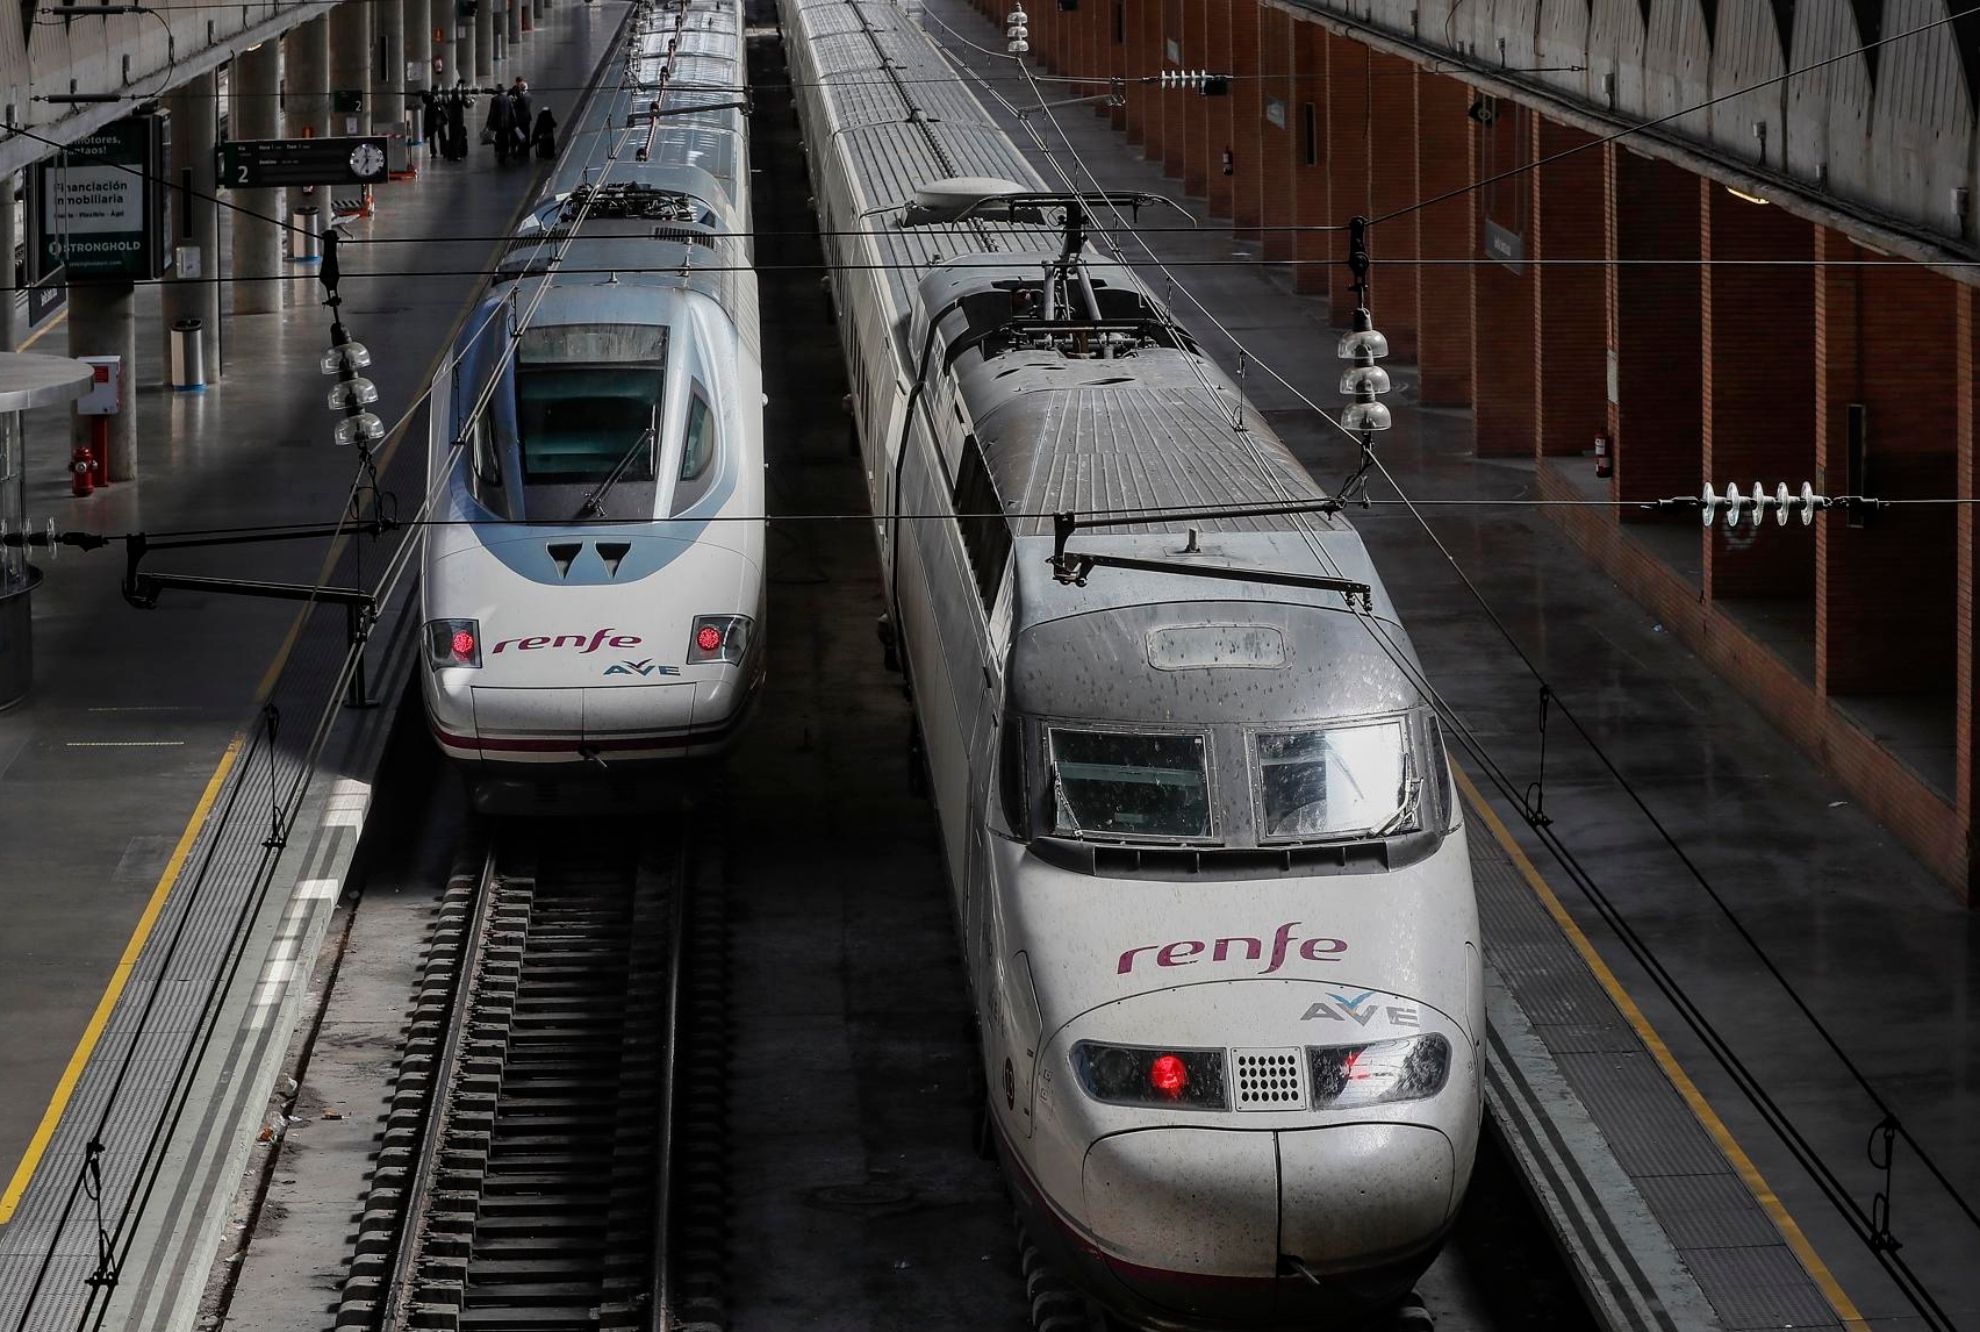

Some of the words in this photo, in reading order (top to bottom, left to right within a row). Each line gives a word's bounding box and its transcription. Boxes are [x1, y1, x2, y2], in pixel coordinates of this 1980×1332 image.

[355, 100, 362, 112] 2
[237, 165, 249, 183] 2
[55, 194, 123, 205] nmobiliaria
[492, 628, 642, 654] renfe
[602, 658, 681, 676] AVE
[1117, 922, 1348, 975] renfe
[1299, 991, 1421, 1028] AVE
